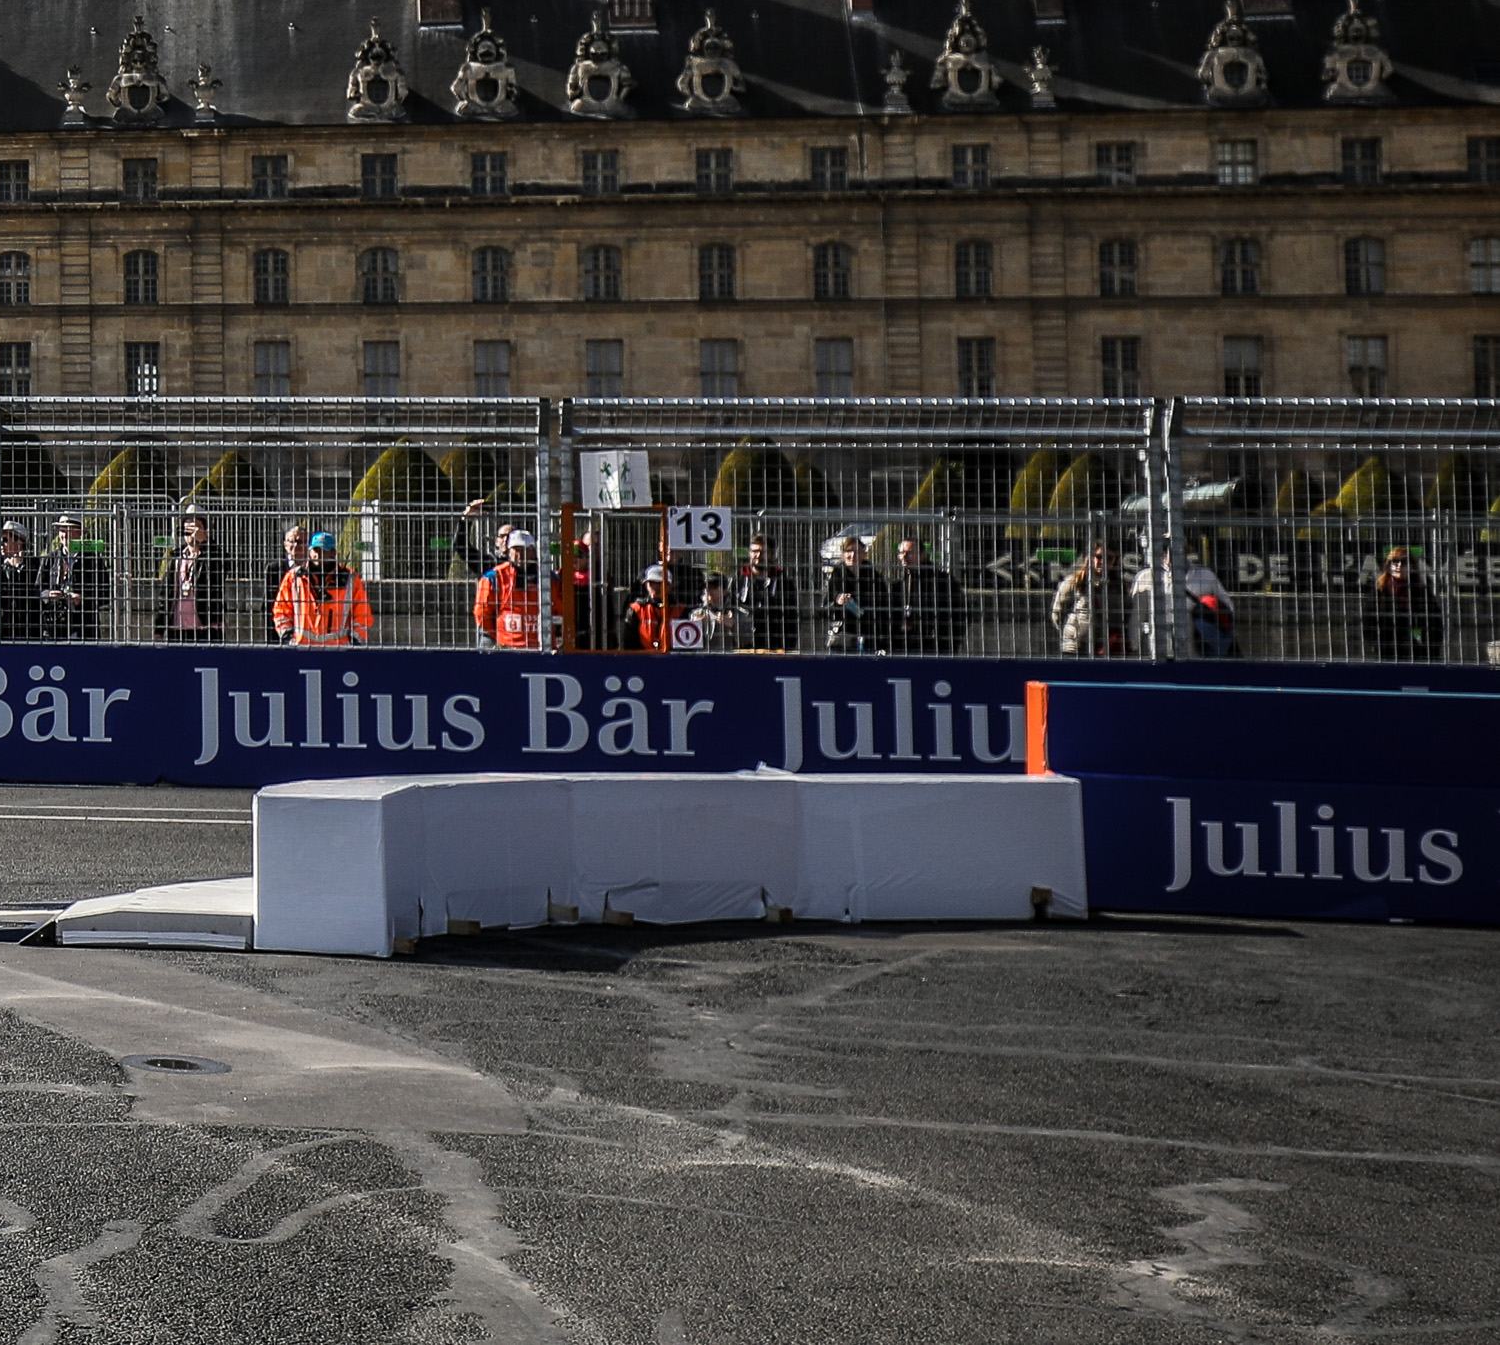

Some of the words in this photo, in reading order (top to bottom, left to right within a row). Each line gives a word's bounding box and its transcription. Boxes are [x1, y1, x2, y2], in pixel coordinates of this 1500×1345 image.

[676, 511, 724, 546] 13
[194, 667, 485, 765] Julius
[521, 673, 714, 756] Bär
[1165, 797, 1464, 893] Julius
